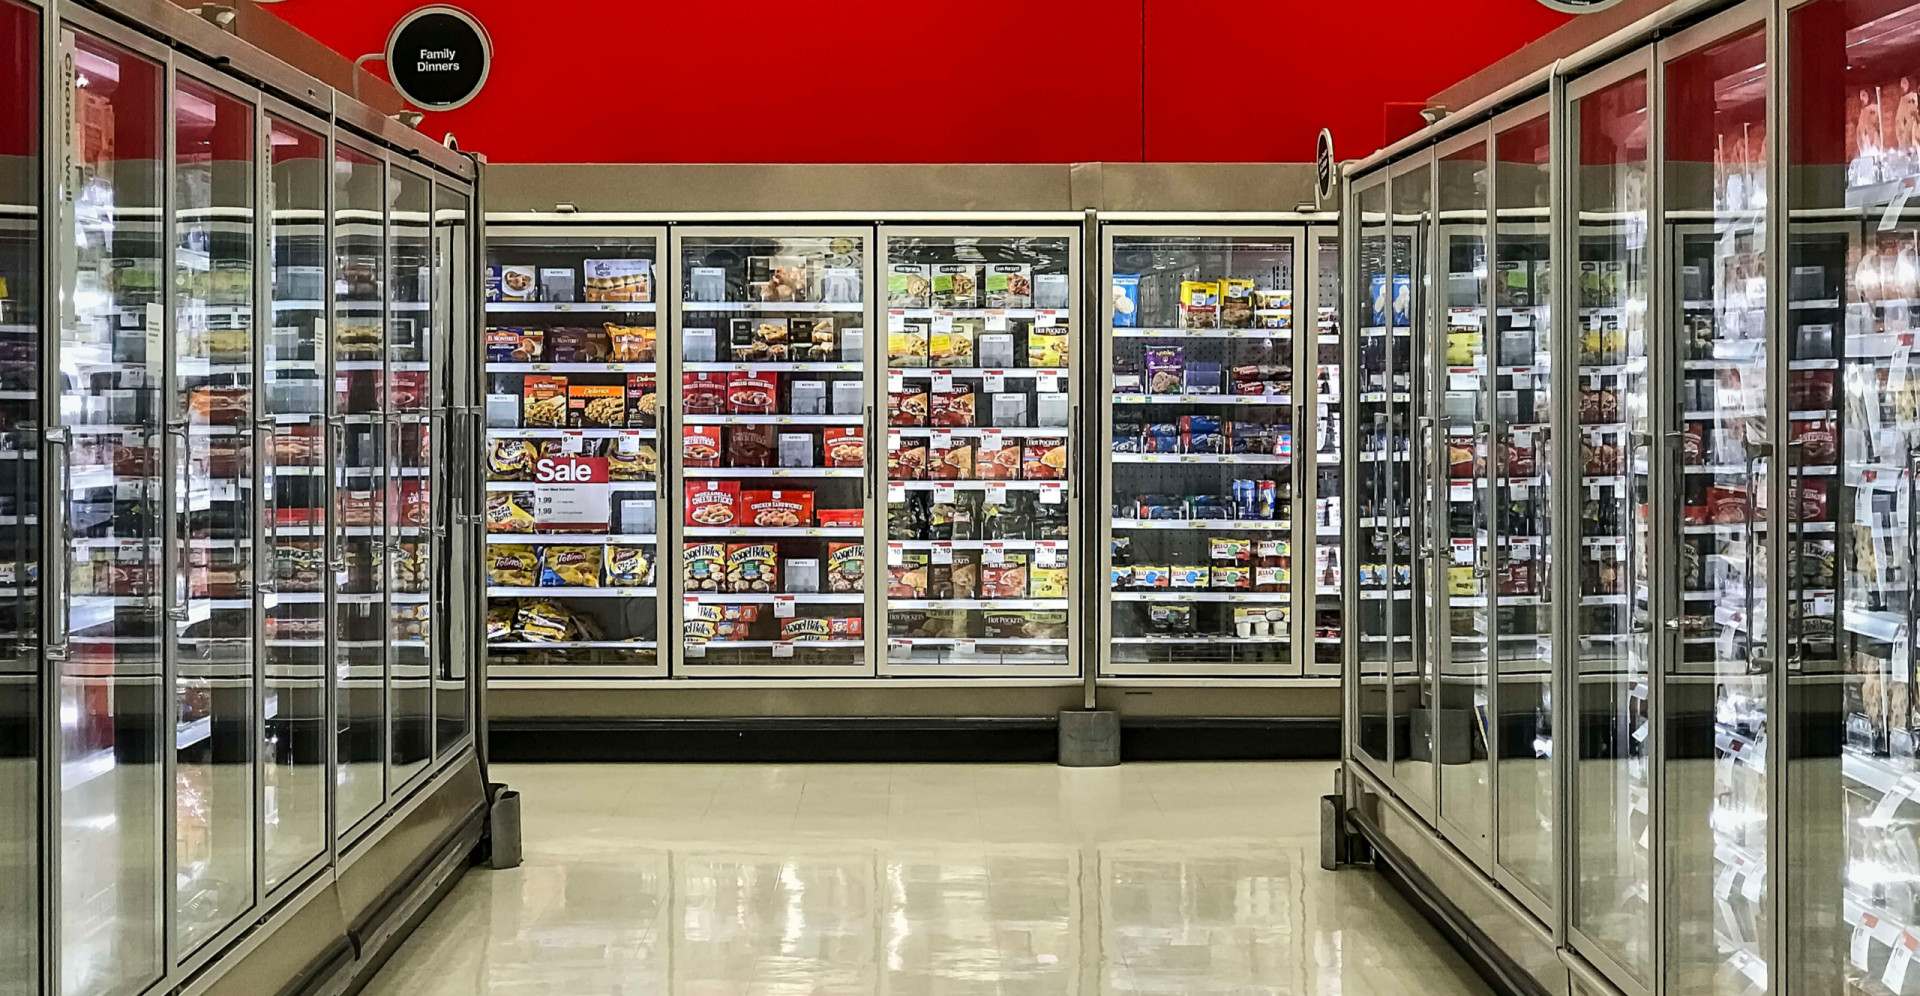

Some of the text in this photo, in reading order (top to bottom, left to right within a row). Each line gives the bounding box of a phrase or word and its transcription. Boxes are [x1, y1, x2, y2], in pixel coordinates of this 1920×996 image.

[420, 48, 456, 61] Family
[417, 62, 460, 72] Dinners
[536, 458, 592, 481] Sale
[692, 495, 733, 505] CHEESE STICKS
[751, 502, 772, 510] CHICKEN
[489, 506, 510, 518] Pizza
[494, 512, 513, 522] Rolls
[702, 545, 720, 558] Bites
[730, 546, 771, 564] Bagel Bites
[832, 549, 854, 562] Bagel
[695, 622, 710, 635] Bites
[785, 621, 824, 633] Bagel Bites
